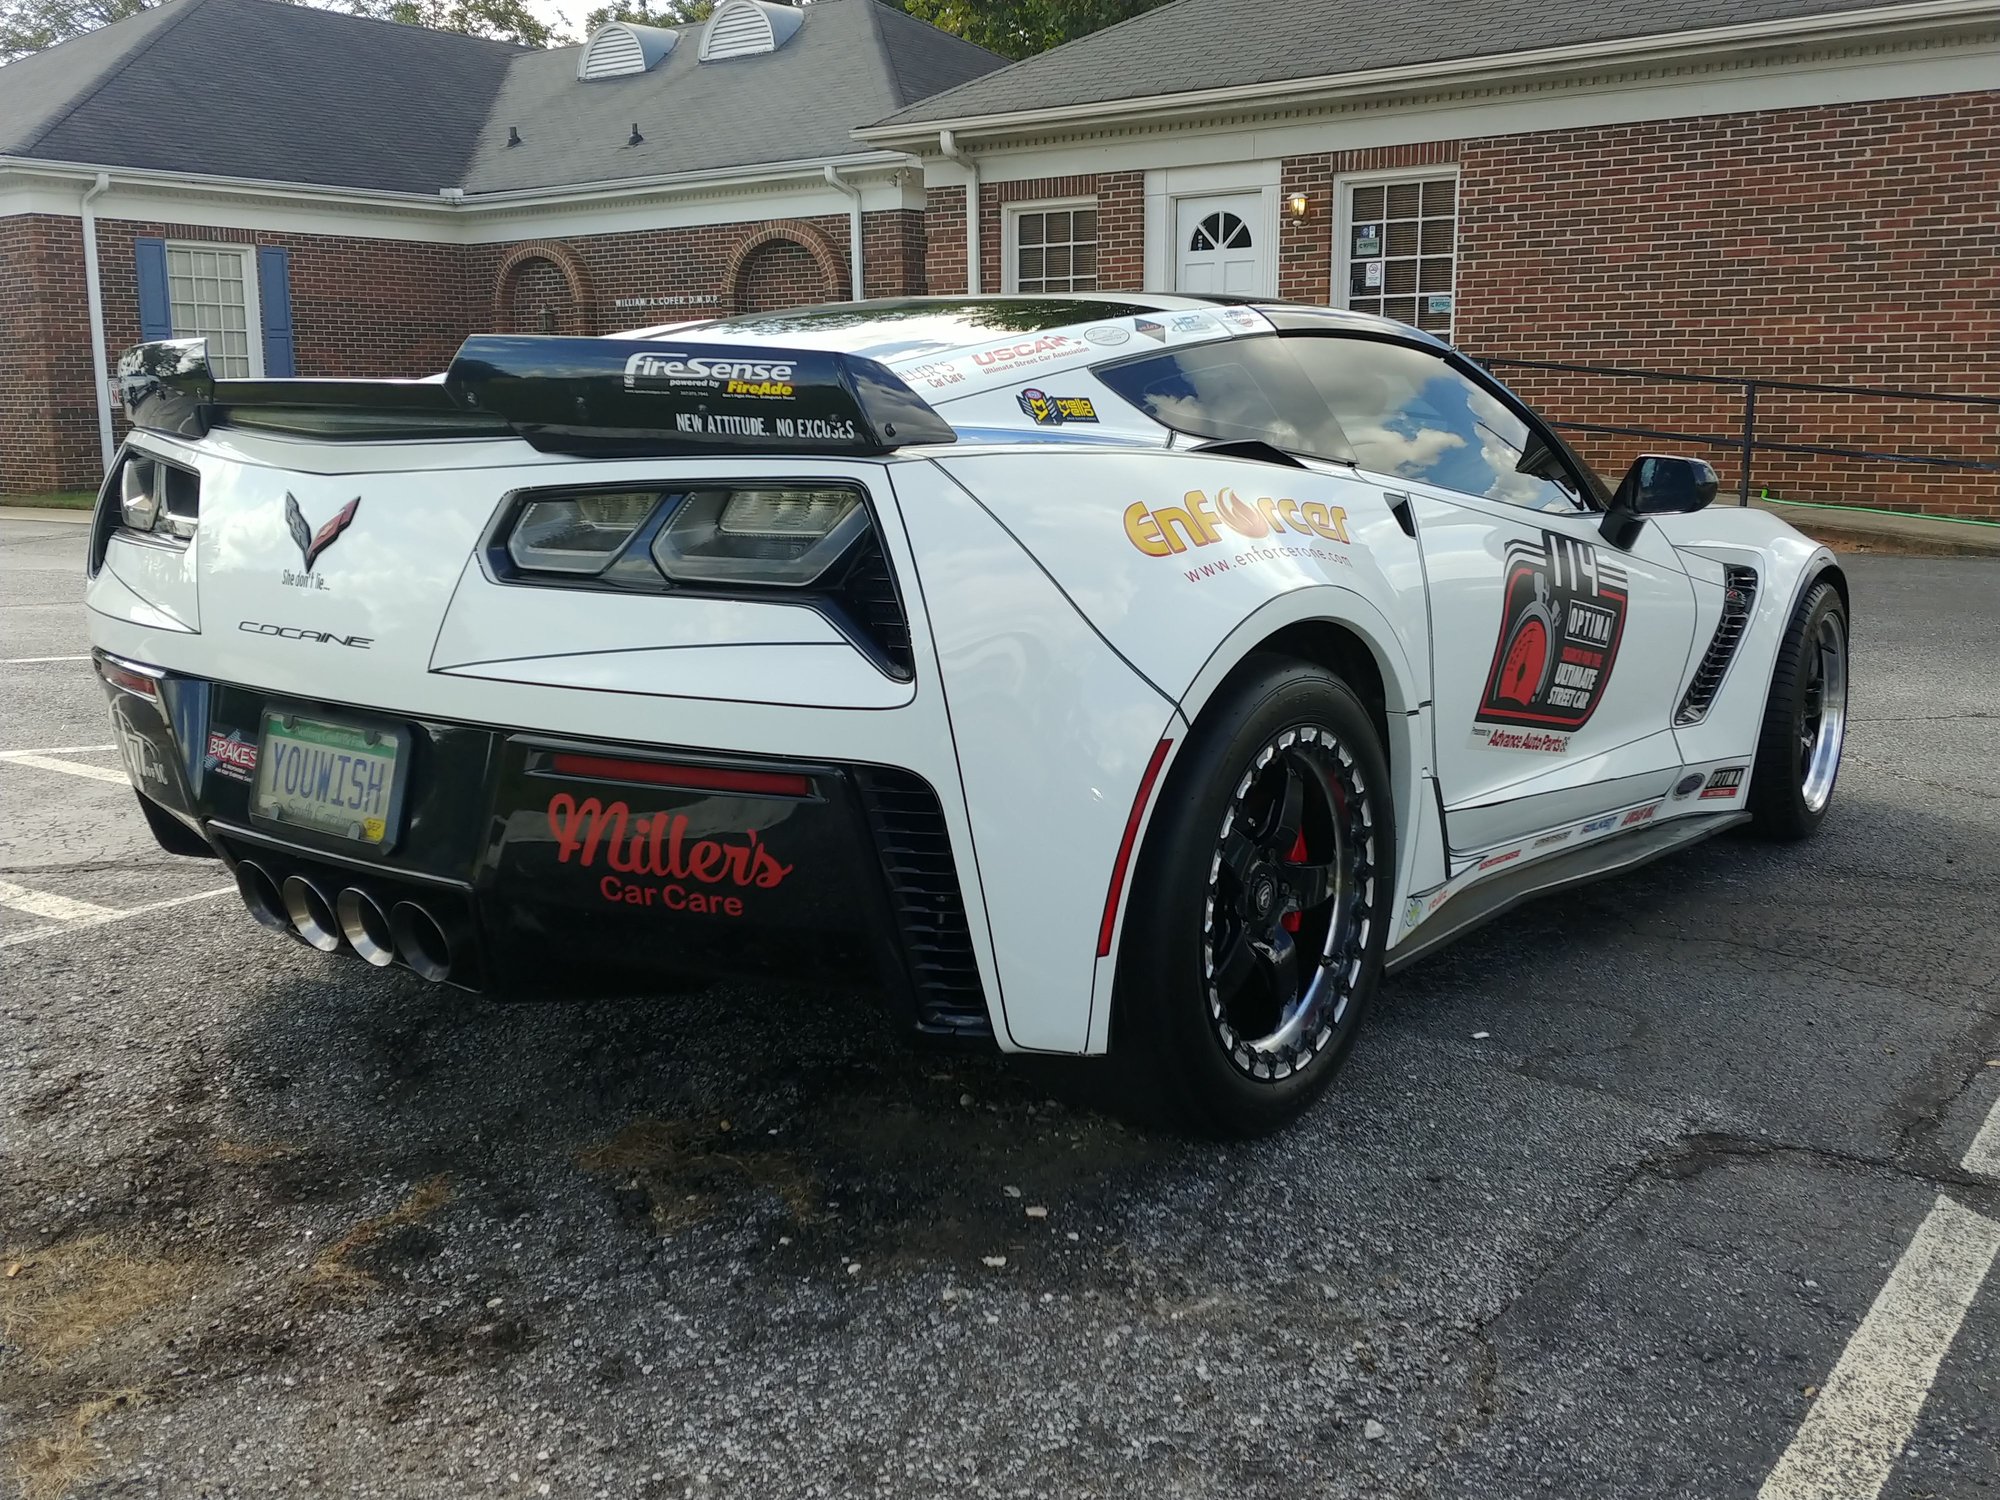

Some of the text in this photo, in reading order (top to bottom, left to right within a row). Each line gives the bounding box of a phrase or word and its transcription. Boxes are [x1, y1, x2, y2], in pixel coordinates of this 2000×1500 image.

[615, 297, 645, 307] WILLIAM
[895, 361, 955, 382] ILLER'S
[983, 364, 1014, 375] Ultimate
[1015, 357, 1038, 367] Street
[1053, 346, 1090, 359] Association
[669, 379, 708, 387] powered
[727, 380, 793, 396] FireAde
[927, 373, 965, 388] Car Care
[675, 413, 855, 440] NEW ATTITUDE. NO EXCUSES
[1184, 545, 1353, 583] www.enforcerone.com
[1548, 535, 1599, 597] 114
[281, 569, 295, 585] She
[295, 573, 314, 588] don't
[238, 621, 375, 649] COCAINE
[1568, 607, 1611, 642] OPTIMA
[1554, 662, 1599, 690] ULTIMATE
[1546, 686, 1591, 709] STREET CAR
[208, 738, 257, 767] BRAKES
[1487, 728, 1523, 749] Advance
[1520, 732, 1542, 750] Auto
[1540, 734, 1563, 753] Parts
[272, 742, 385, 815] YOUWISH
[548, 793, 794, 888] Miller's
[600, 876, 744, 916] Car Care
